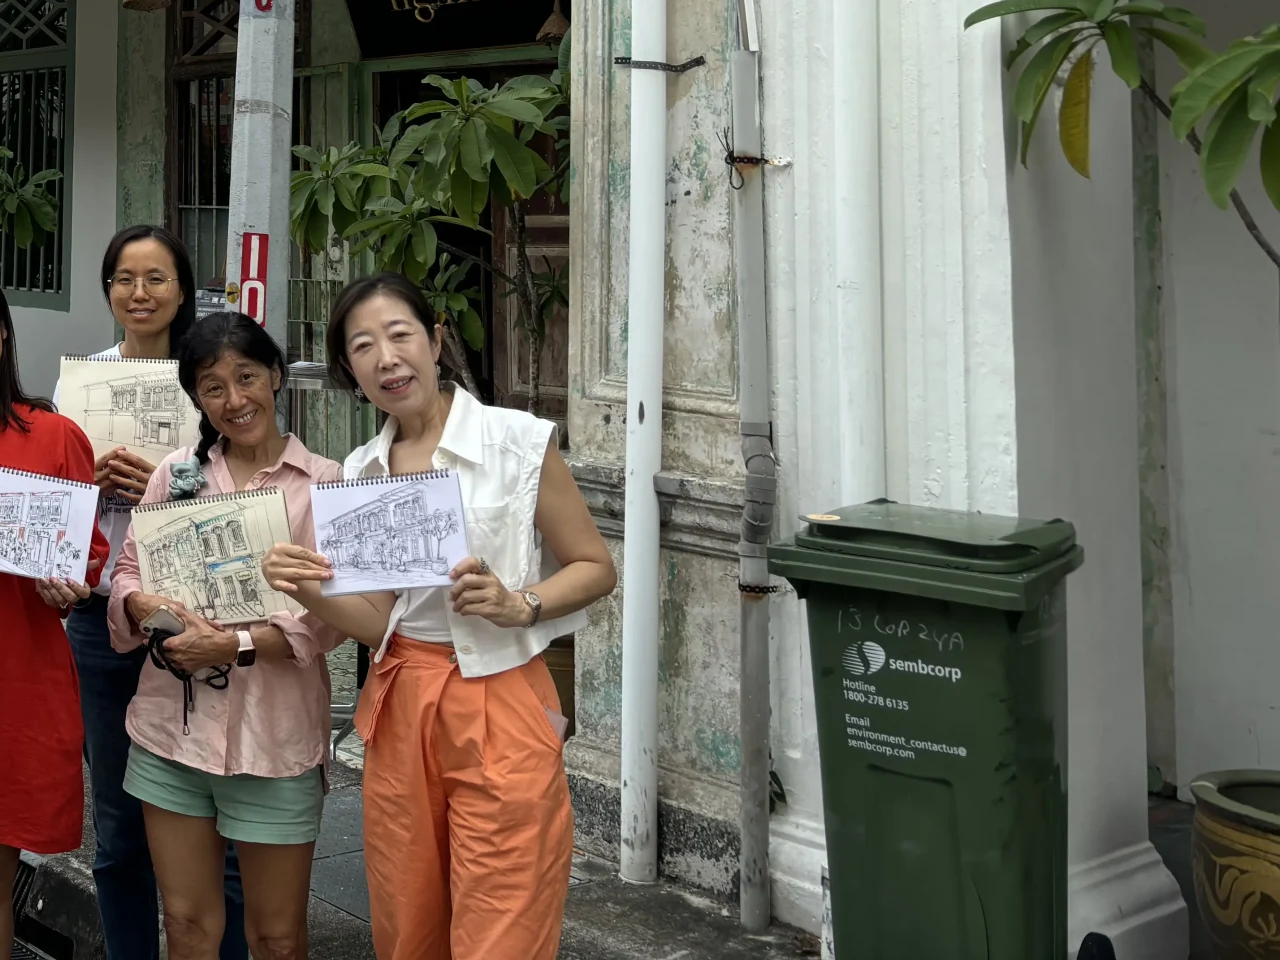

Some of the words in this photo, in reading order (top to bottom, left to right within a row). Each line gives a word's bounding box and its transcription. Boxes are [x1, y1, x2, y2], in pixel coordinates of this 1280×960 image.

[889, 658, 962, 682] sembcorp
[843, 678, 876, 693] Hotline
[844, 690, 885, 706] 1800-278
[886, 698, 909, 710] 6135
[845, 713, 870, 727] Email
[847, 727, 967, 756] environment_contactus@
[848, 738, 915, 759] sembcorp.com
